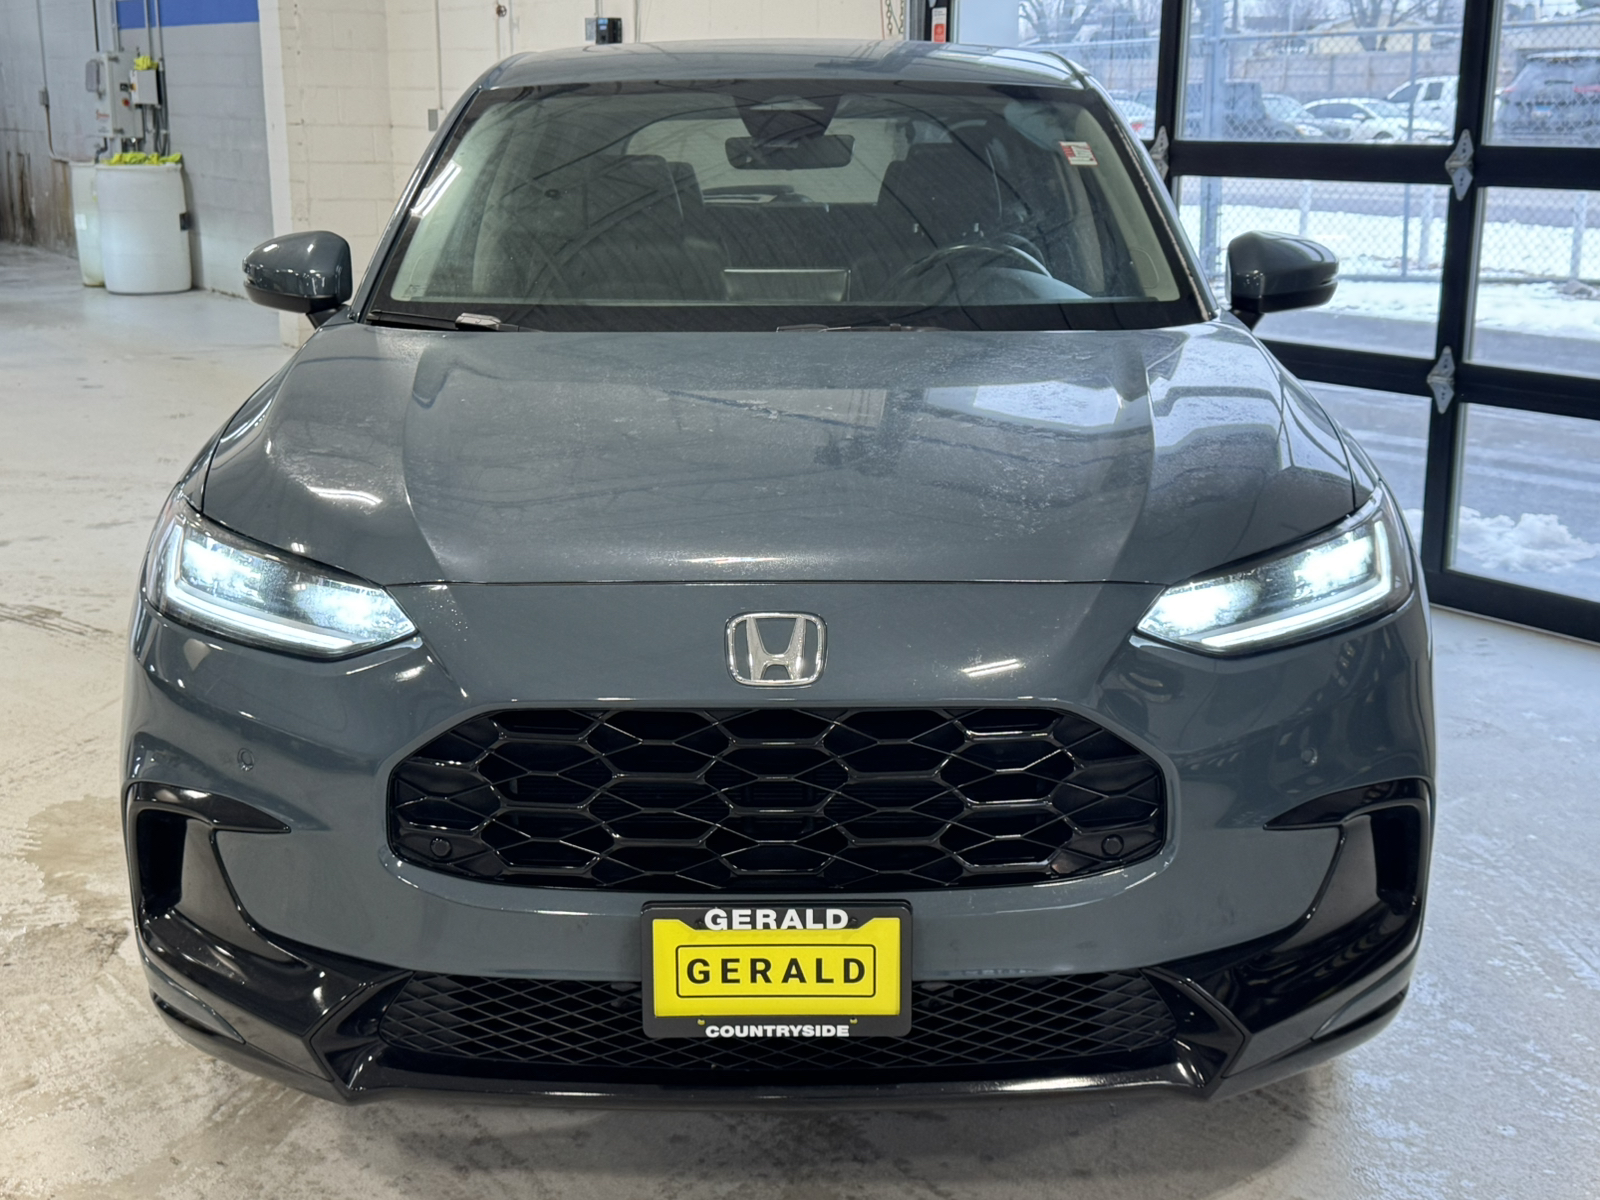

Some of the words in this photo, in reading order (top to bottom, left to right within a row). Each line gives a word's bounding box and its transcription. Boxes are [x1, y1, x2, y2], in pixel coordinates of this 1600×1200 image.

[704, 908, 849, 931] GERALD
[687, 958, 865, 984] GERALD
[705, 1025, 849, 1038] COUNTRYSIDE
